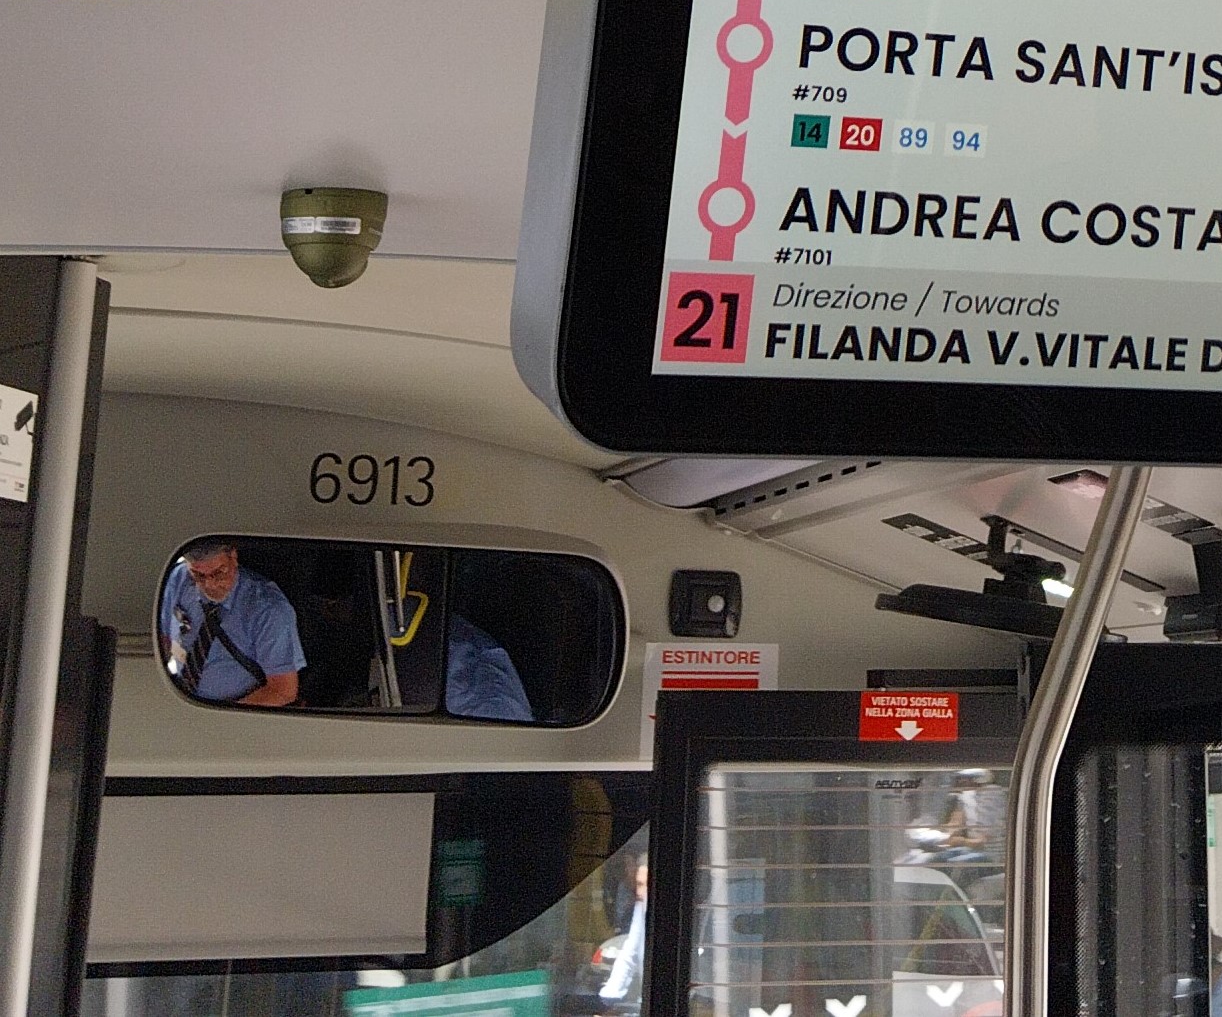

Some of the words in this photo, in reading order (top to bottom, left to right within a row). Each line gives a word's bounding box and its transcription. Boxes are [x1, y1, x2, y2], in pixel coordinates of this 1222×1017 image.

[798, 24, 994, 81] PORTA
[792, 85, 848, 103] #709
[798, 121, 823, 144] 14
[846, 124, 876, 147] 20
[899, 127, 929, 149] 89
[951, 131, 981, 152] 94
[778, 187, 1021, 242] ANDREA
[774, 247, 832, 266] #7101
[772, 282, 909, 312] Direzione
[914, 282, 935, 317] /
[942, 290, 1061, 317] Towards
[673, 290, 741, 349] 21
[764, 323, 972, 365] FILANDA
[987, 331, 1189, 372] V.VITALE
[309, 453, 436, 508] 6913
[662, 650, 761, 665] ESTINTORE
[865, 708, 894, 717] NELLA
[895, 708, 920, 718] ZONA
[922, 708, 953, 718] GIALLA
[871, 697, 908, 707] VIETATO
[910, 697, 949, 707] SOSTARE
